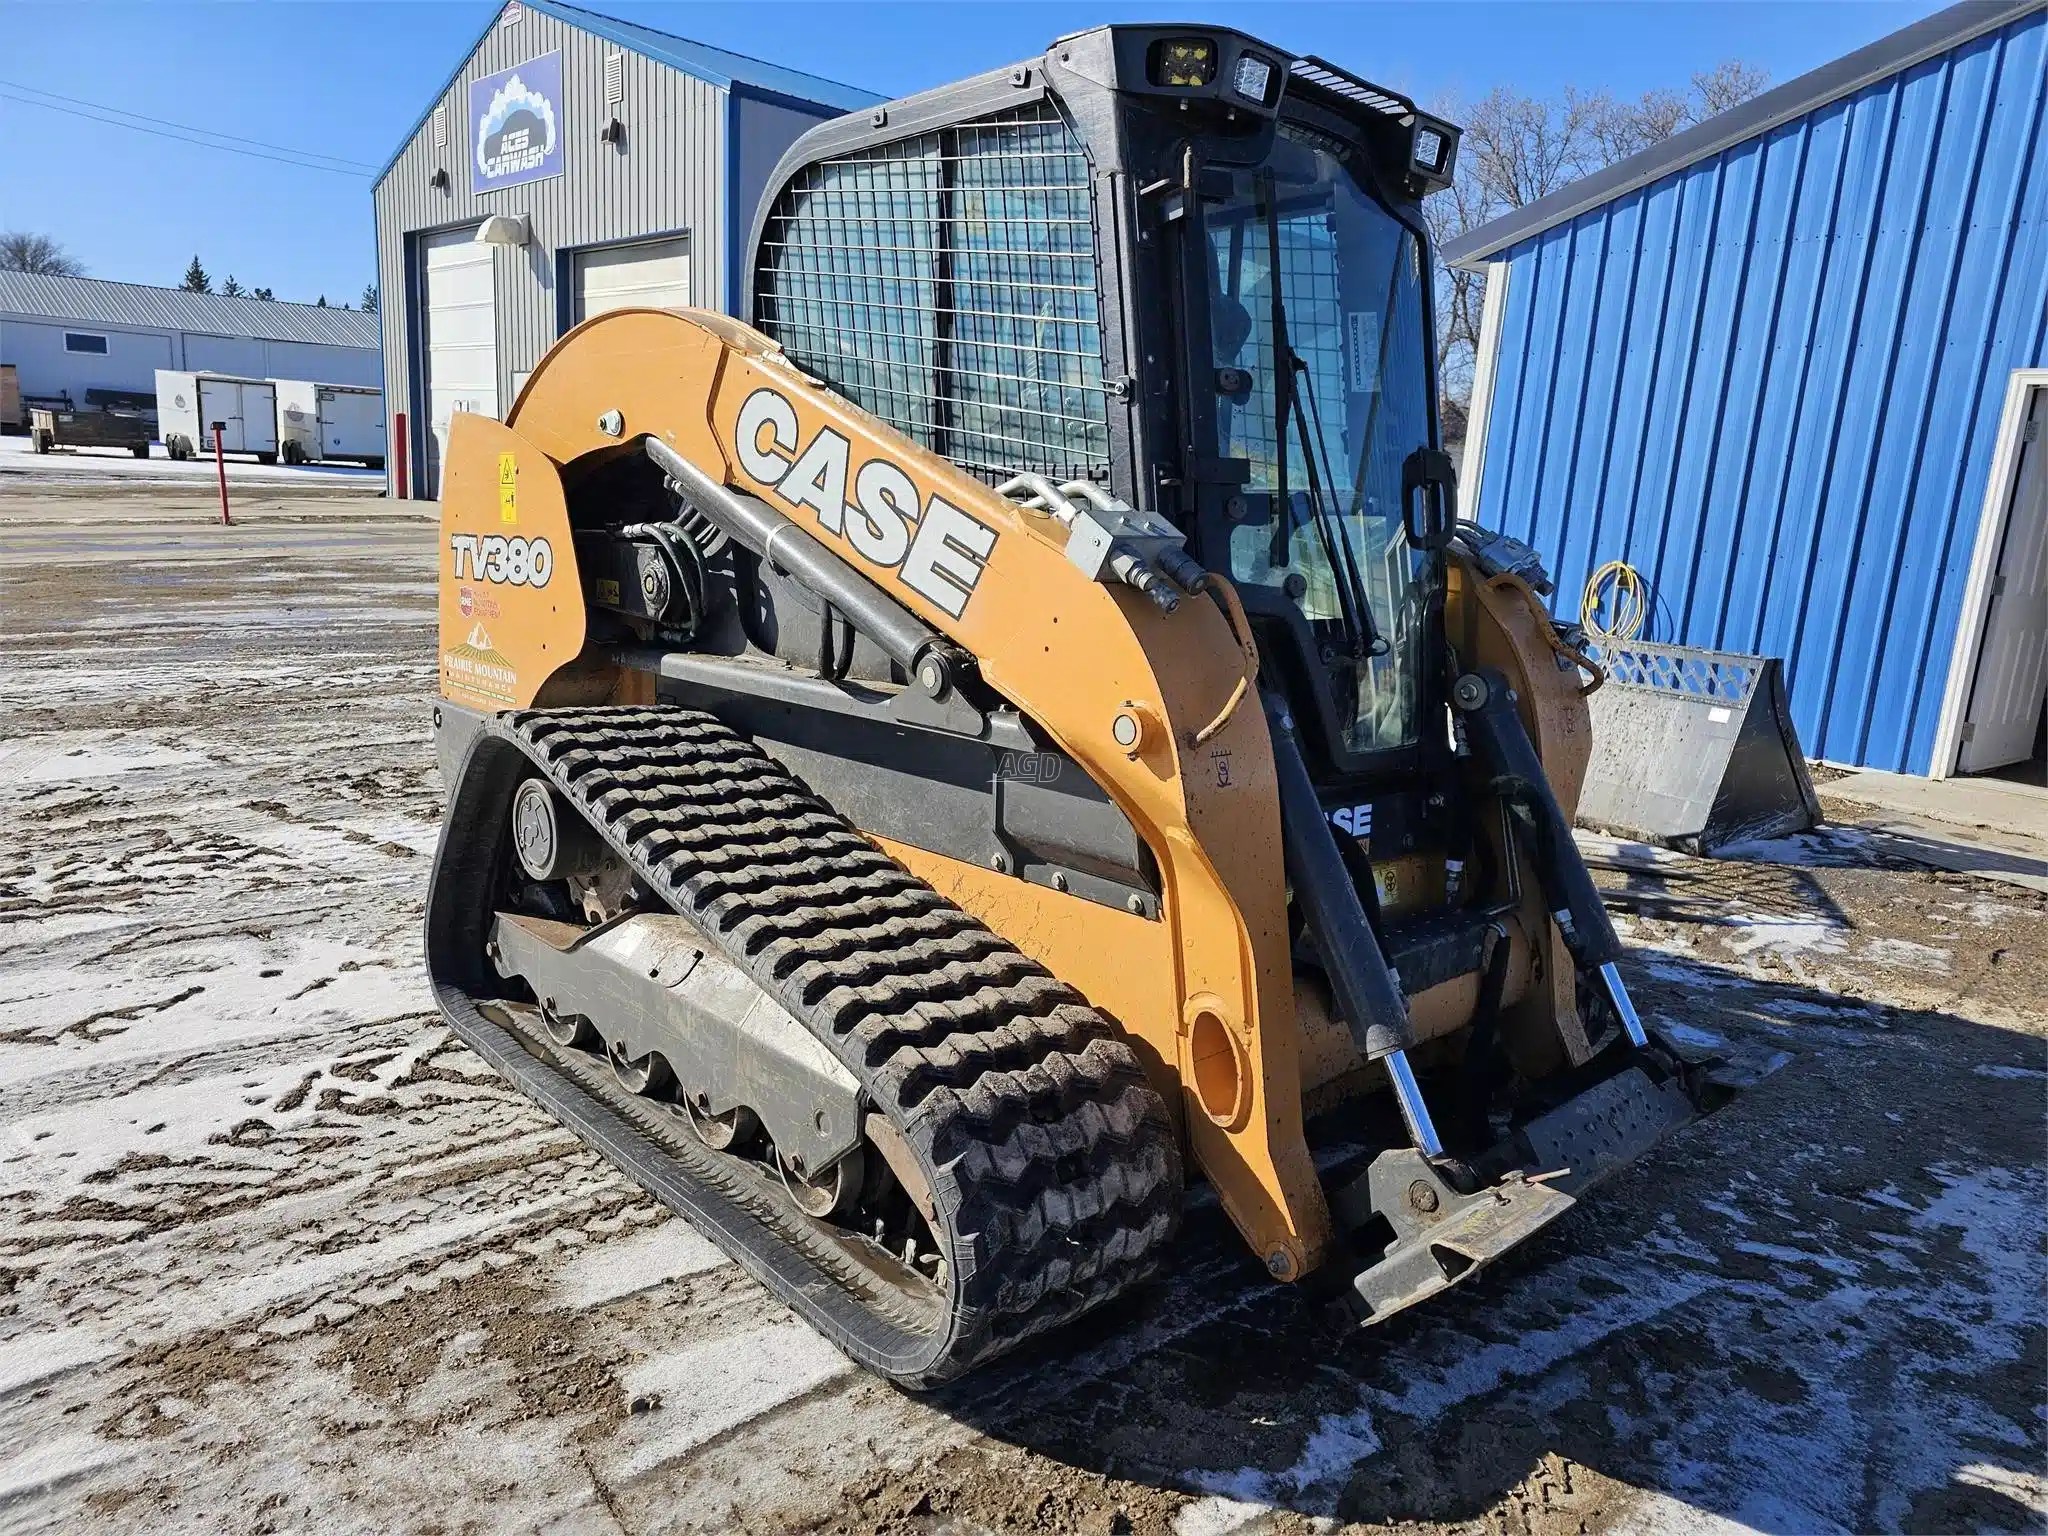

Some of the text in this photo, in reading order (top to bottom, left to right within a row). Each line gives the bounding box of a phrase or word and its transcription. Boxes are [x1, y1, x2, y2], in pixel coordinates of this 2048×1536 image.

[486, 144, 545, 179] CARWASH
[735, 387, 1000, 621] CASE
[451, 532, 553, 589] TV380
[474, 663, 517, 685] MOUNTAIN
[1324, 803, 1373, 837] SE
